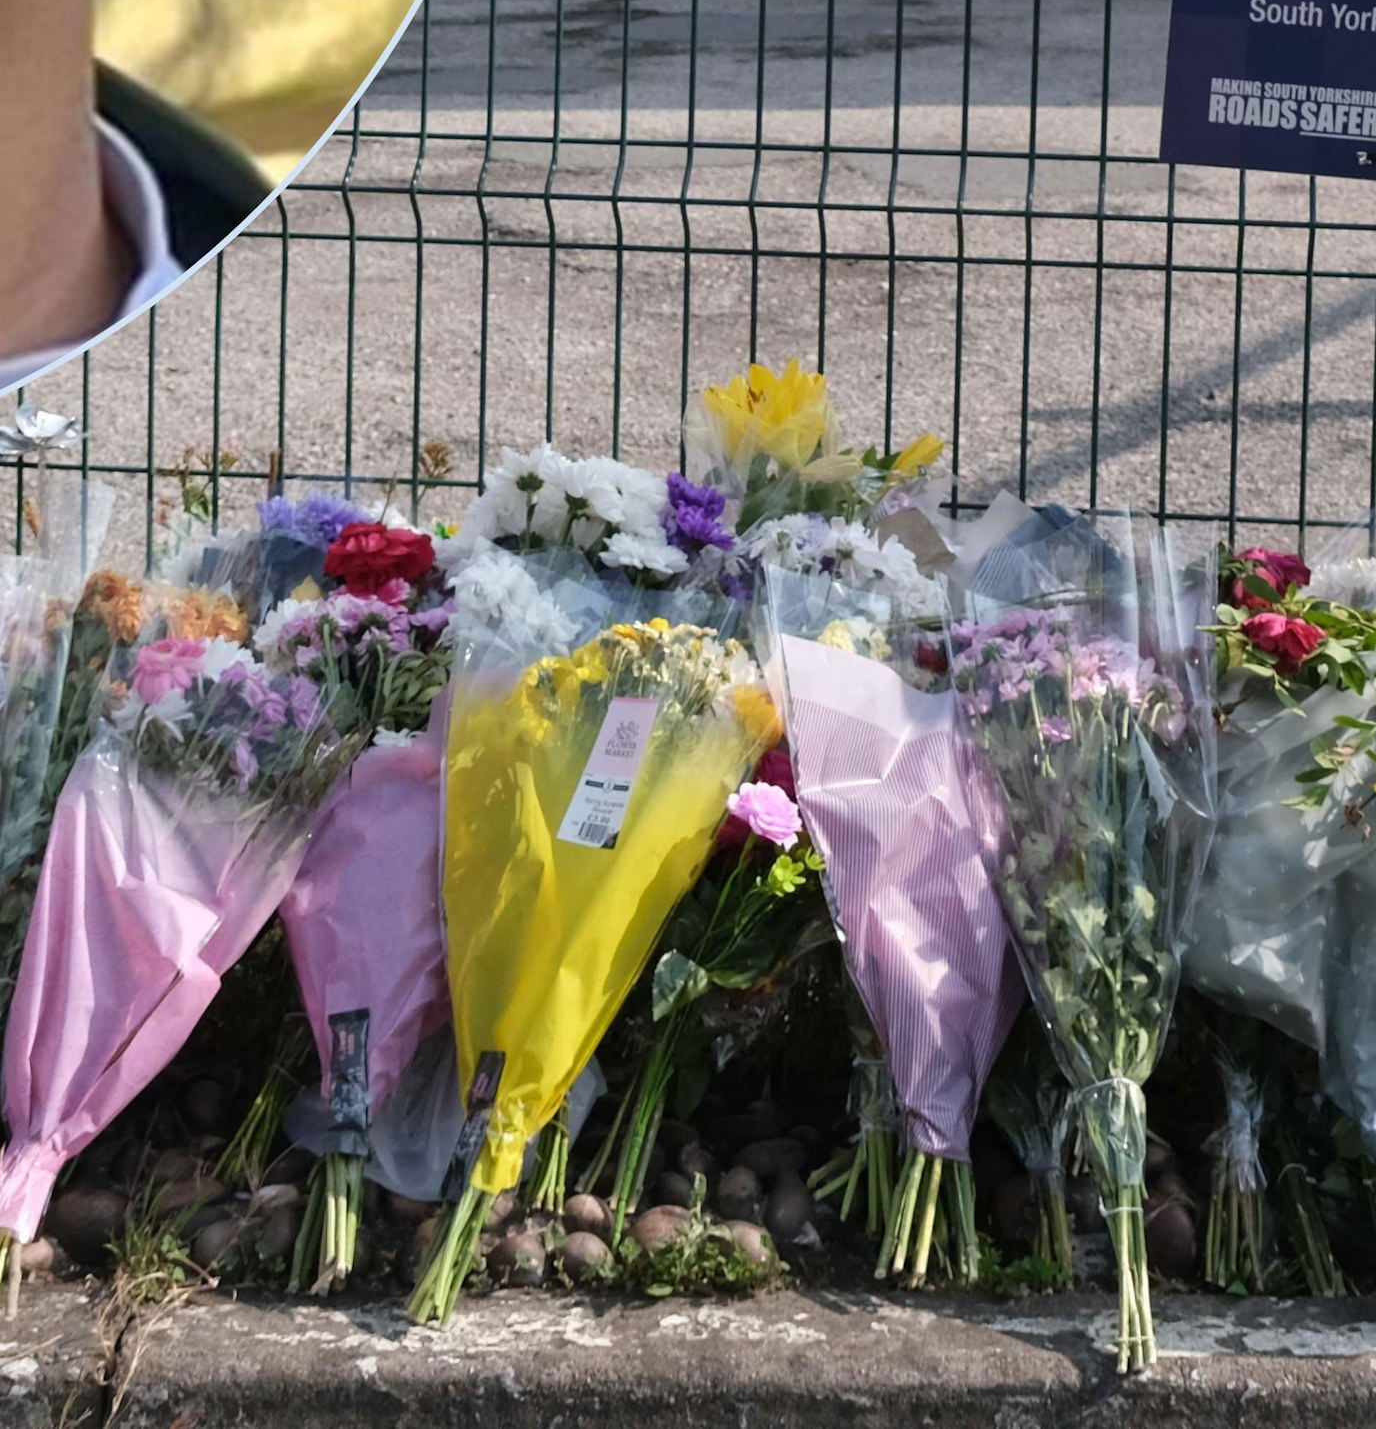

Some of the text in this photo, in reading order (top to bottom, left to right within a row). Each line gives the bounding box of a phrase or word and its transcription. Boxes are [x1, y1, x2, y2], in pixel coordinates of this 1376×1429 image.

[1210, 77, 1262, 96] MAKING
[1263, 81, 1308, 101] SOUTH
[1208, 93, 1298, 130] ROADS
